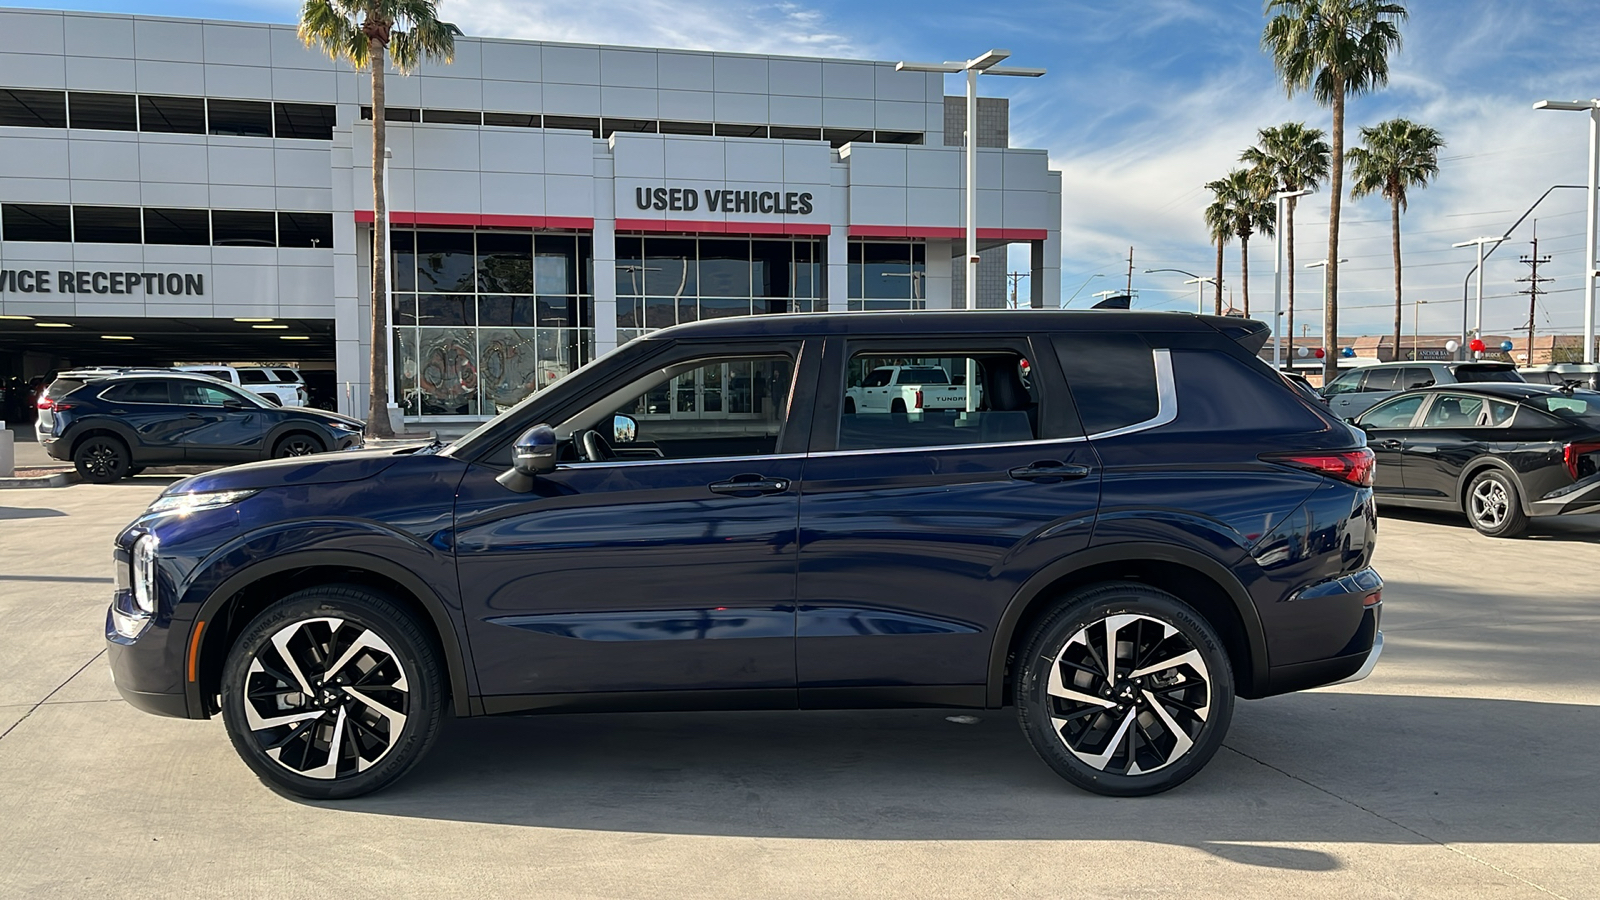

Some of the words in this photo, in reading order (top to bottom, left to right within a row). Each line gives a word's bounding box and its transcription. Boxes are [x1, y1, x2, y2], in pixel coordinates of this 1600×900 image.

[636, 187, 698, 211] USED
[705, 189, 813, 214] VEHICLES
[58, 270, 204, 296] RECEPTION
[242, 611, 286, 650] OMNIMAX
[1176, 611, 1217, 653] OMNIMAX
